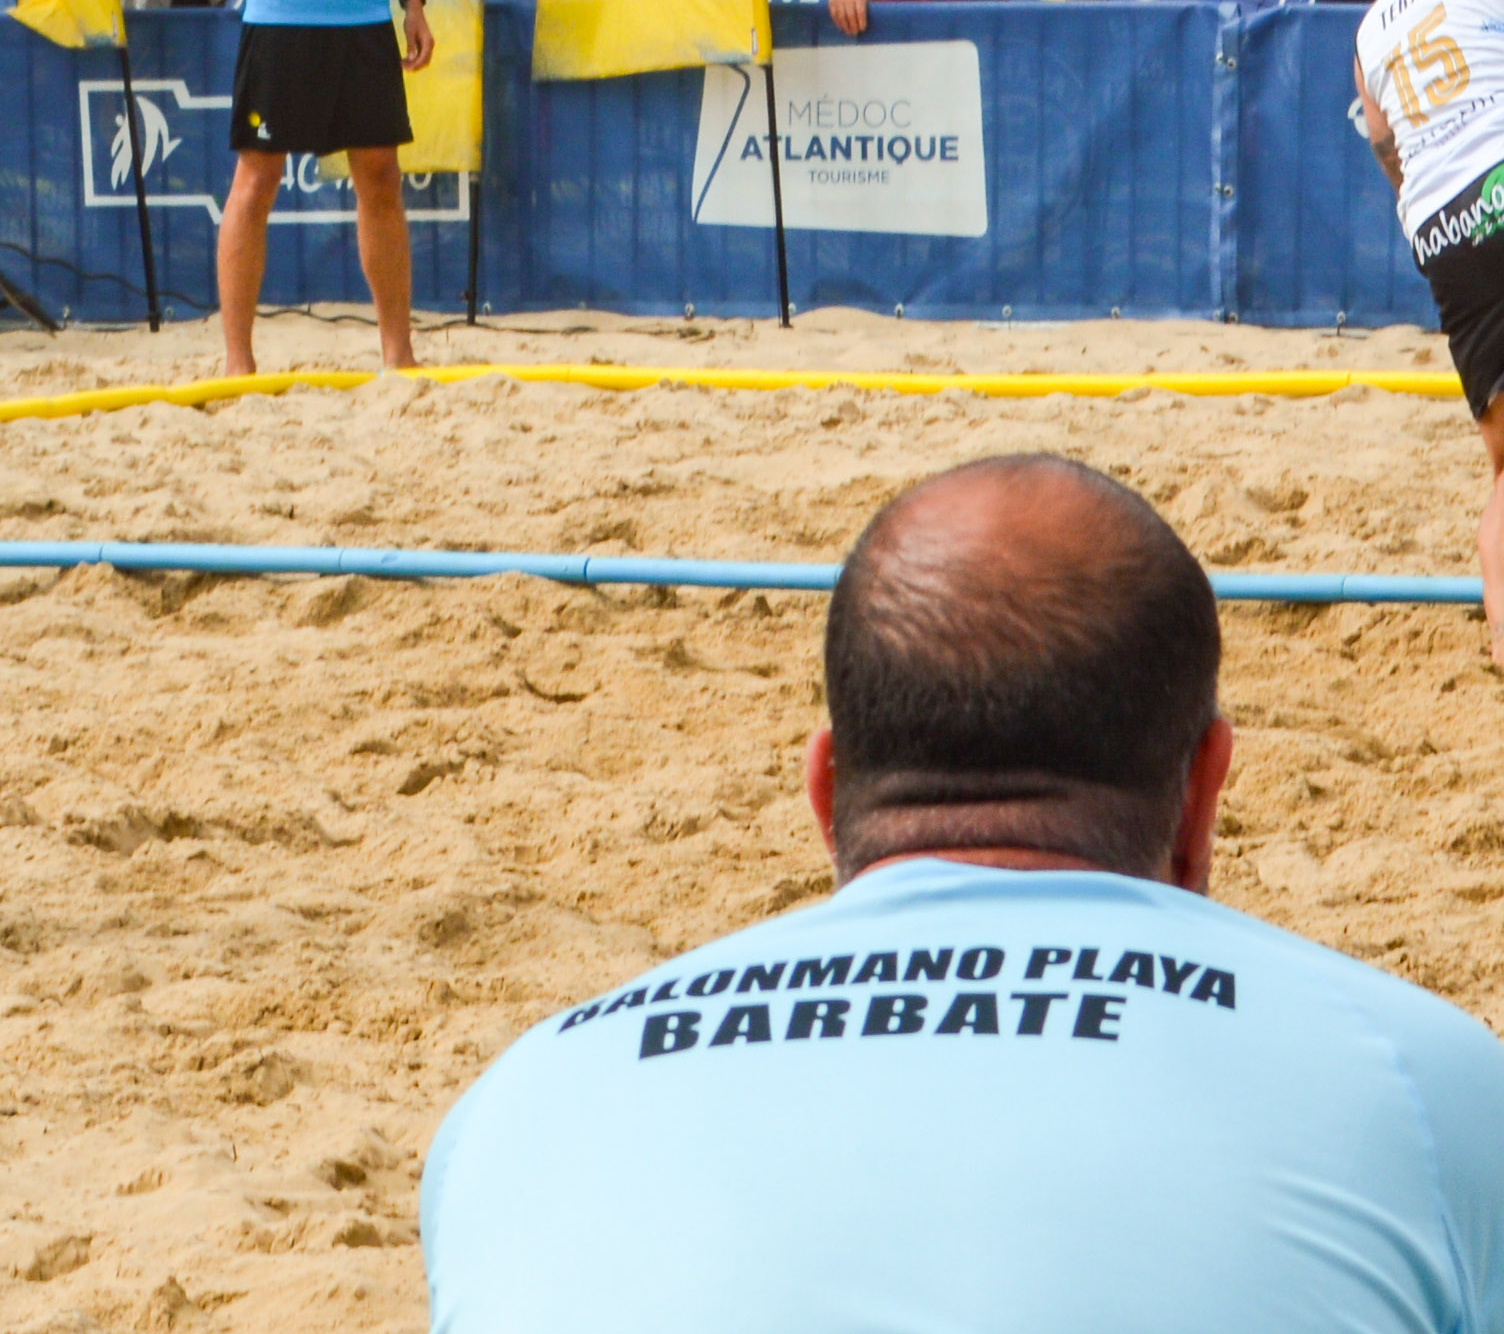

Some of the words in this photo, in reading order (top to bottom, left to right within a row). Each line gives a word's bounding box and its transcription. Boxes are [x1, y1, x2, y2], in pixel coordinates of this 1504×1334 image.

[1383, 0, 1471, 129] 15
[788, 94, 912, 131] MÉDOC
[741, 136, 959, 166] ATLANTIQUE
[808, 169, 891, 185] TOURISME
[556, 946, 1005, 1036] BALONMANO
[1024, 946, 1238, 1011] PLAYA
[638, 992, 1129, 1061] BARBATE
